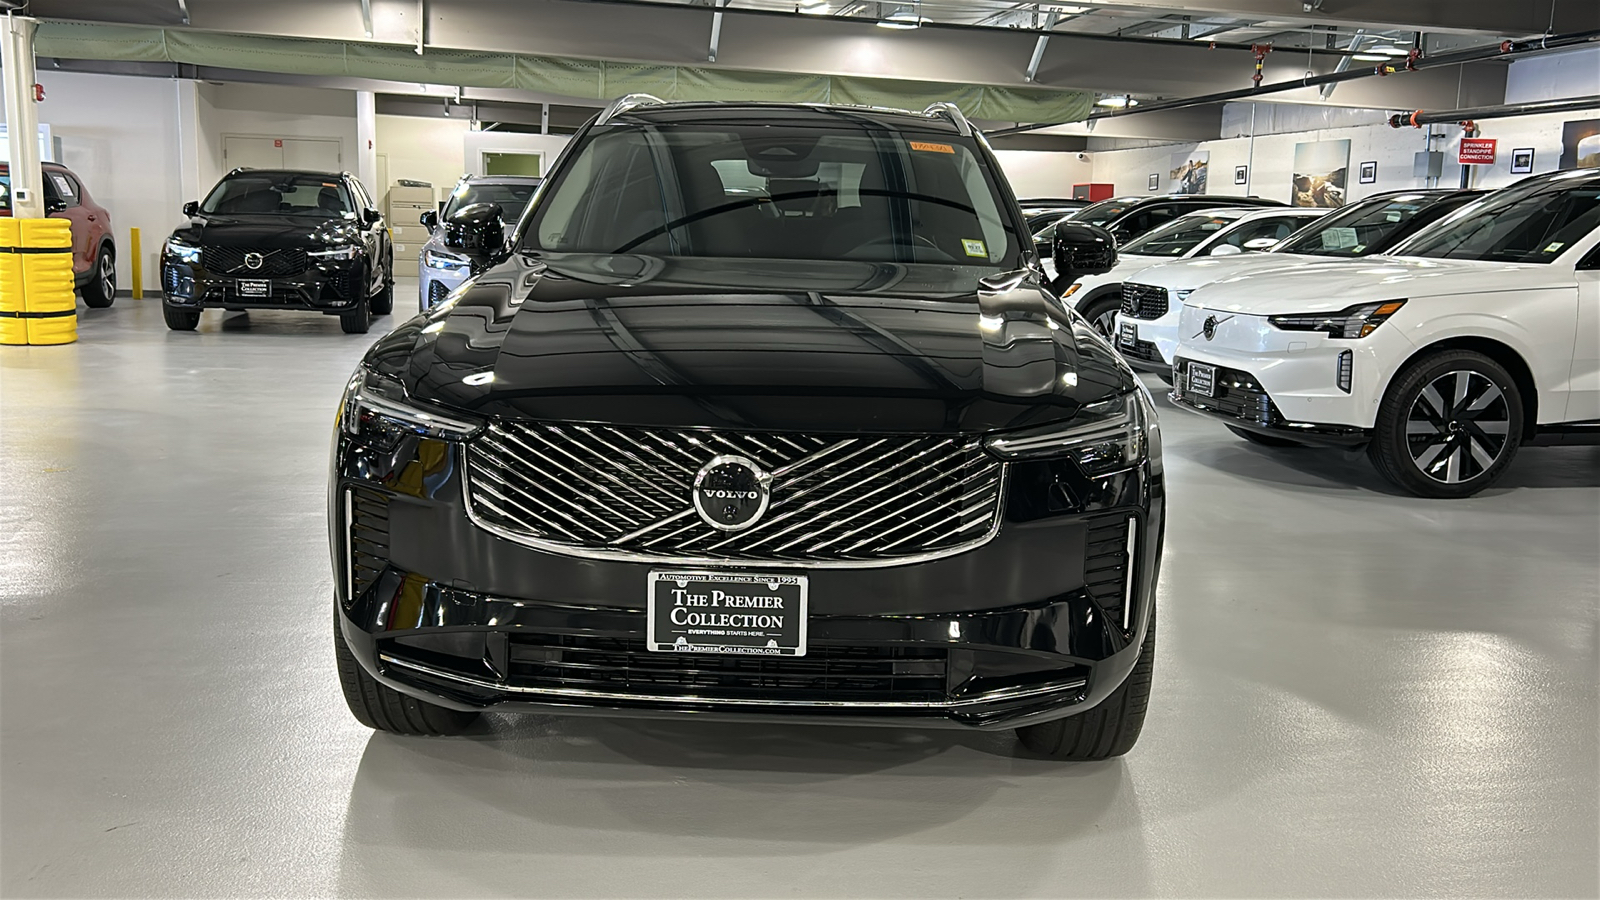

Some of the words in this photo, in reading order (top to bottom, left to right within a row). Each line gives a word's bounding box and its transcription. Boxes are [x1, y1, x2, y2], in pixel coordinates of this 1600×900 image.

[703, 489, 758, 499] VOLVO
[660, 574, 706, 582] AUTOMOTIVE
[671, 589, 708, 607] THE
[711, 590, 784, 608] PREMIER
[670, 607, 784, 628] COLLECTION
[673, 644, 781, 654] THEPREMIERCOLLECTION.COM
